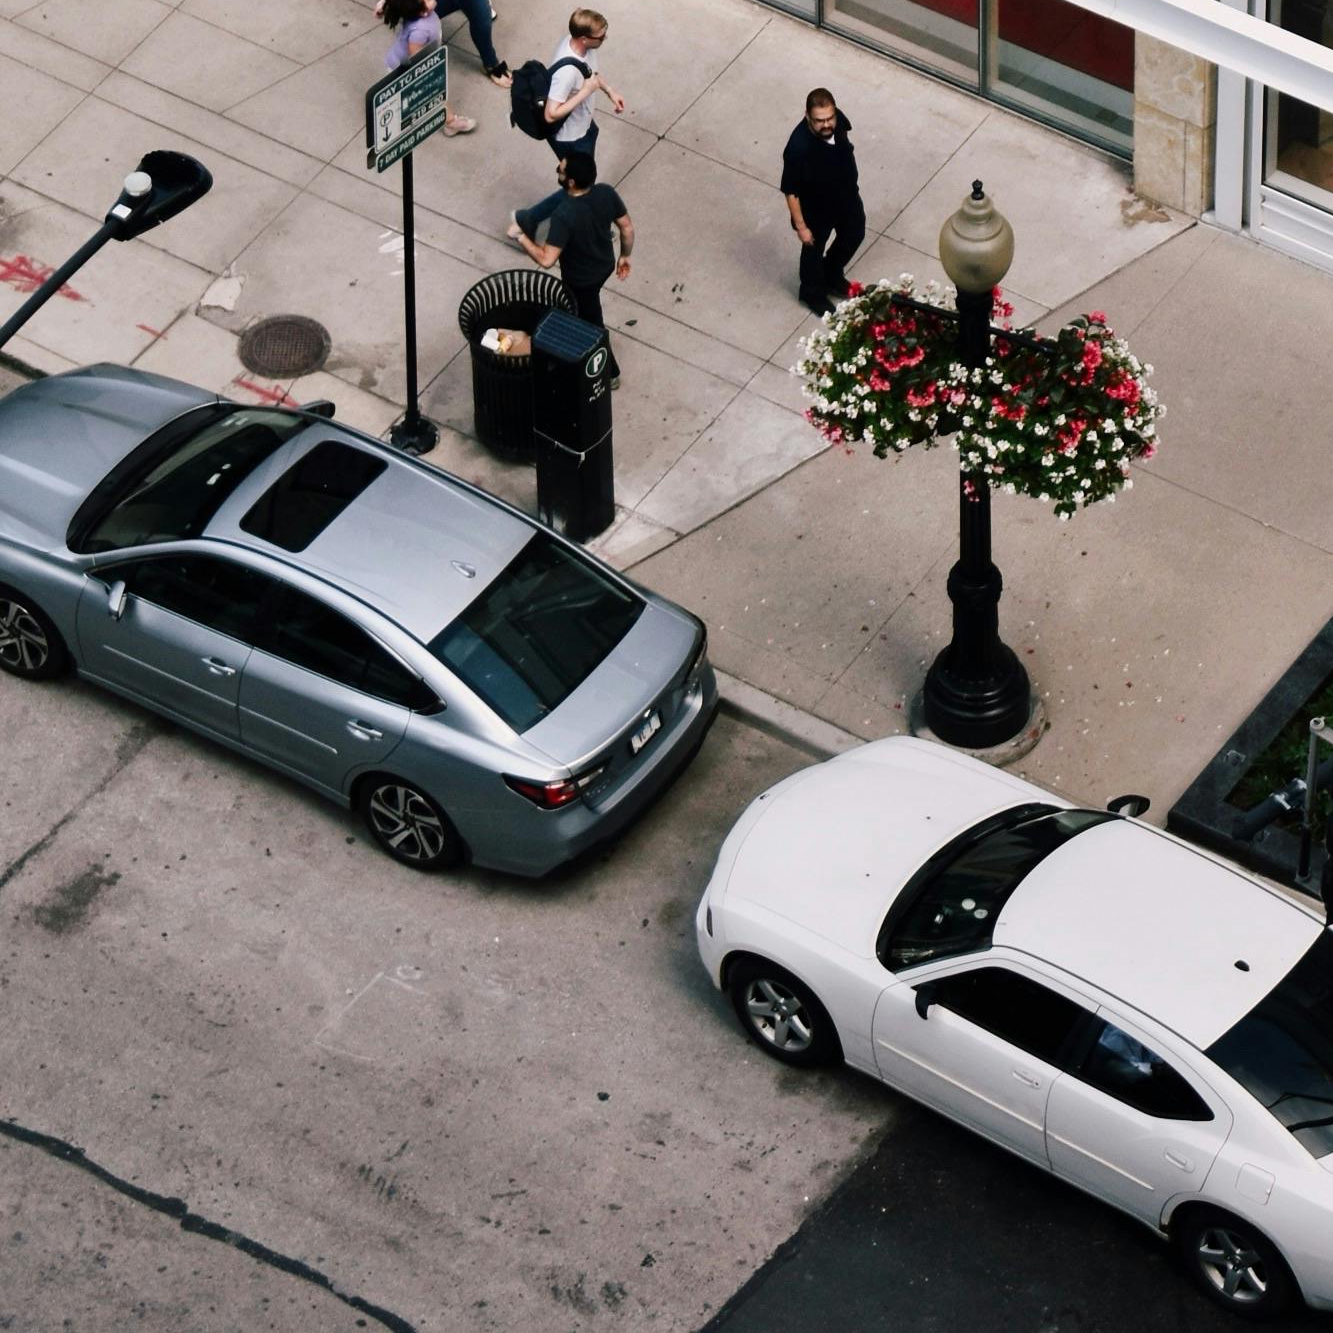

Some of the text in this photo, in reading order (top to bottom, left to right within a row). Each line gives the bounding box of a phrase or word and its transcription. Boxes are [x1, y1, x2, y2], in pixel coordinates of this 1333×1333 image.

[379, 85, 397, 102] PAY
[400, 75, 413, 89] TO
[414, 53, 441, 77] PARK
[385, 148, 399, 164] DAY
[399, 134, 415, 152] PAID
[416, 113, 445, 139] PARKING
